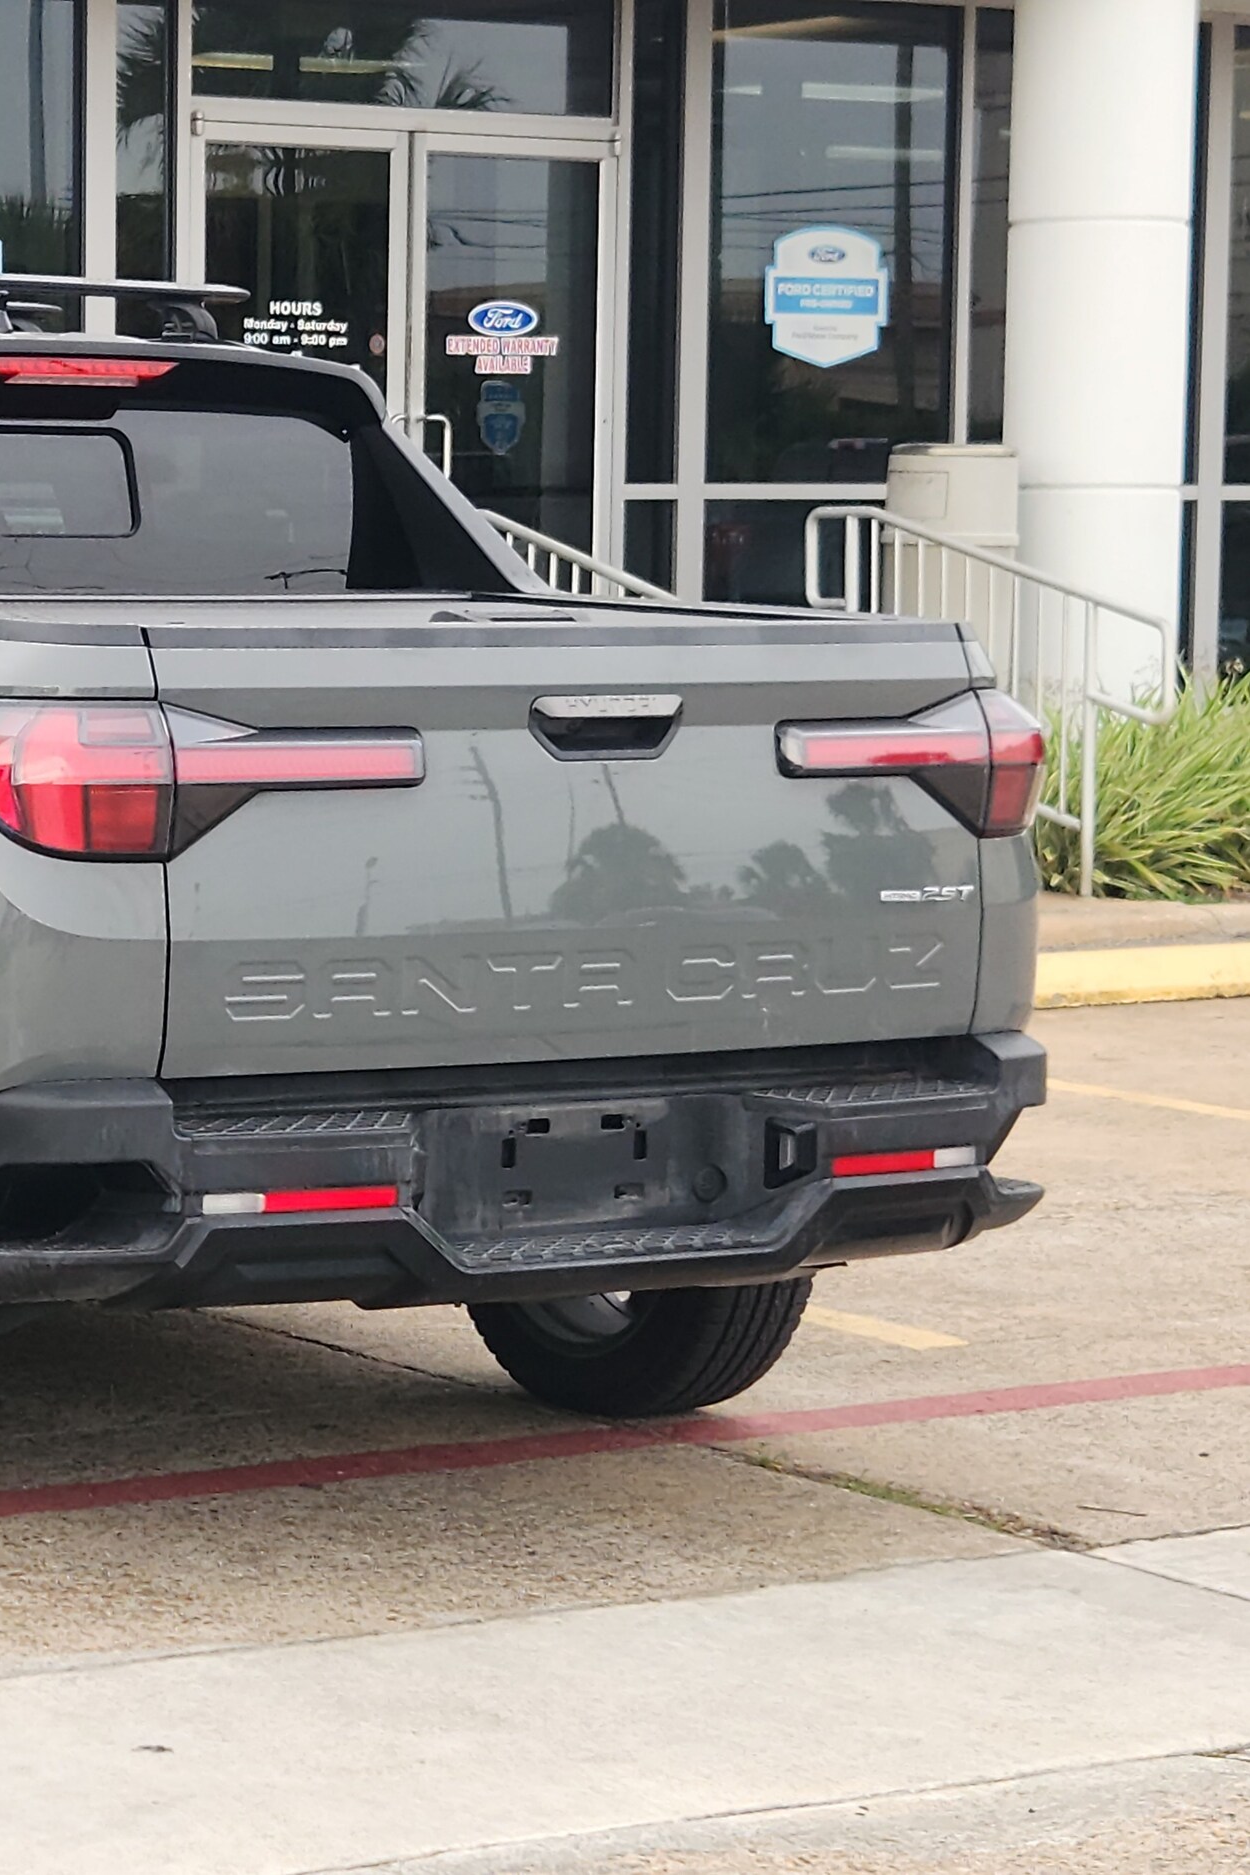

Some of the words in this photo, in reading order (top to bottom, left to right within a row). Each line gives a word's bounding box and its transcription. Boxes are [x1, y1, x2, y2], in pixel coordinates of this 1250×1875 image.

[777, 283, 811, 296] FORD
[813, 284, 874, 297] CERTIFIED
[270, 301, 323, 316] HOURS
[243, 318, 288, 332] Monday
[297, 319, 348, 333] Saturday
[483, 308, 524, 329] Ford
[447, 337, 499, 354] EXTENDED
[501, 338, 558, 355] WARRANTY
[477, 356, 529, 373] AVAILABLE
[224, 946, 637, 1021] SANTA
[664, 933, 945, 1002] CRUZ
